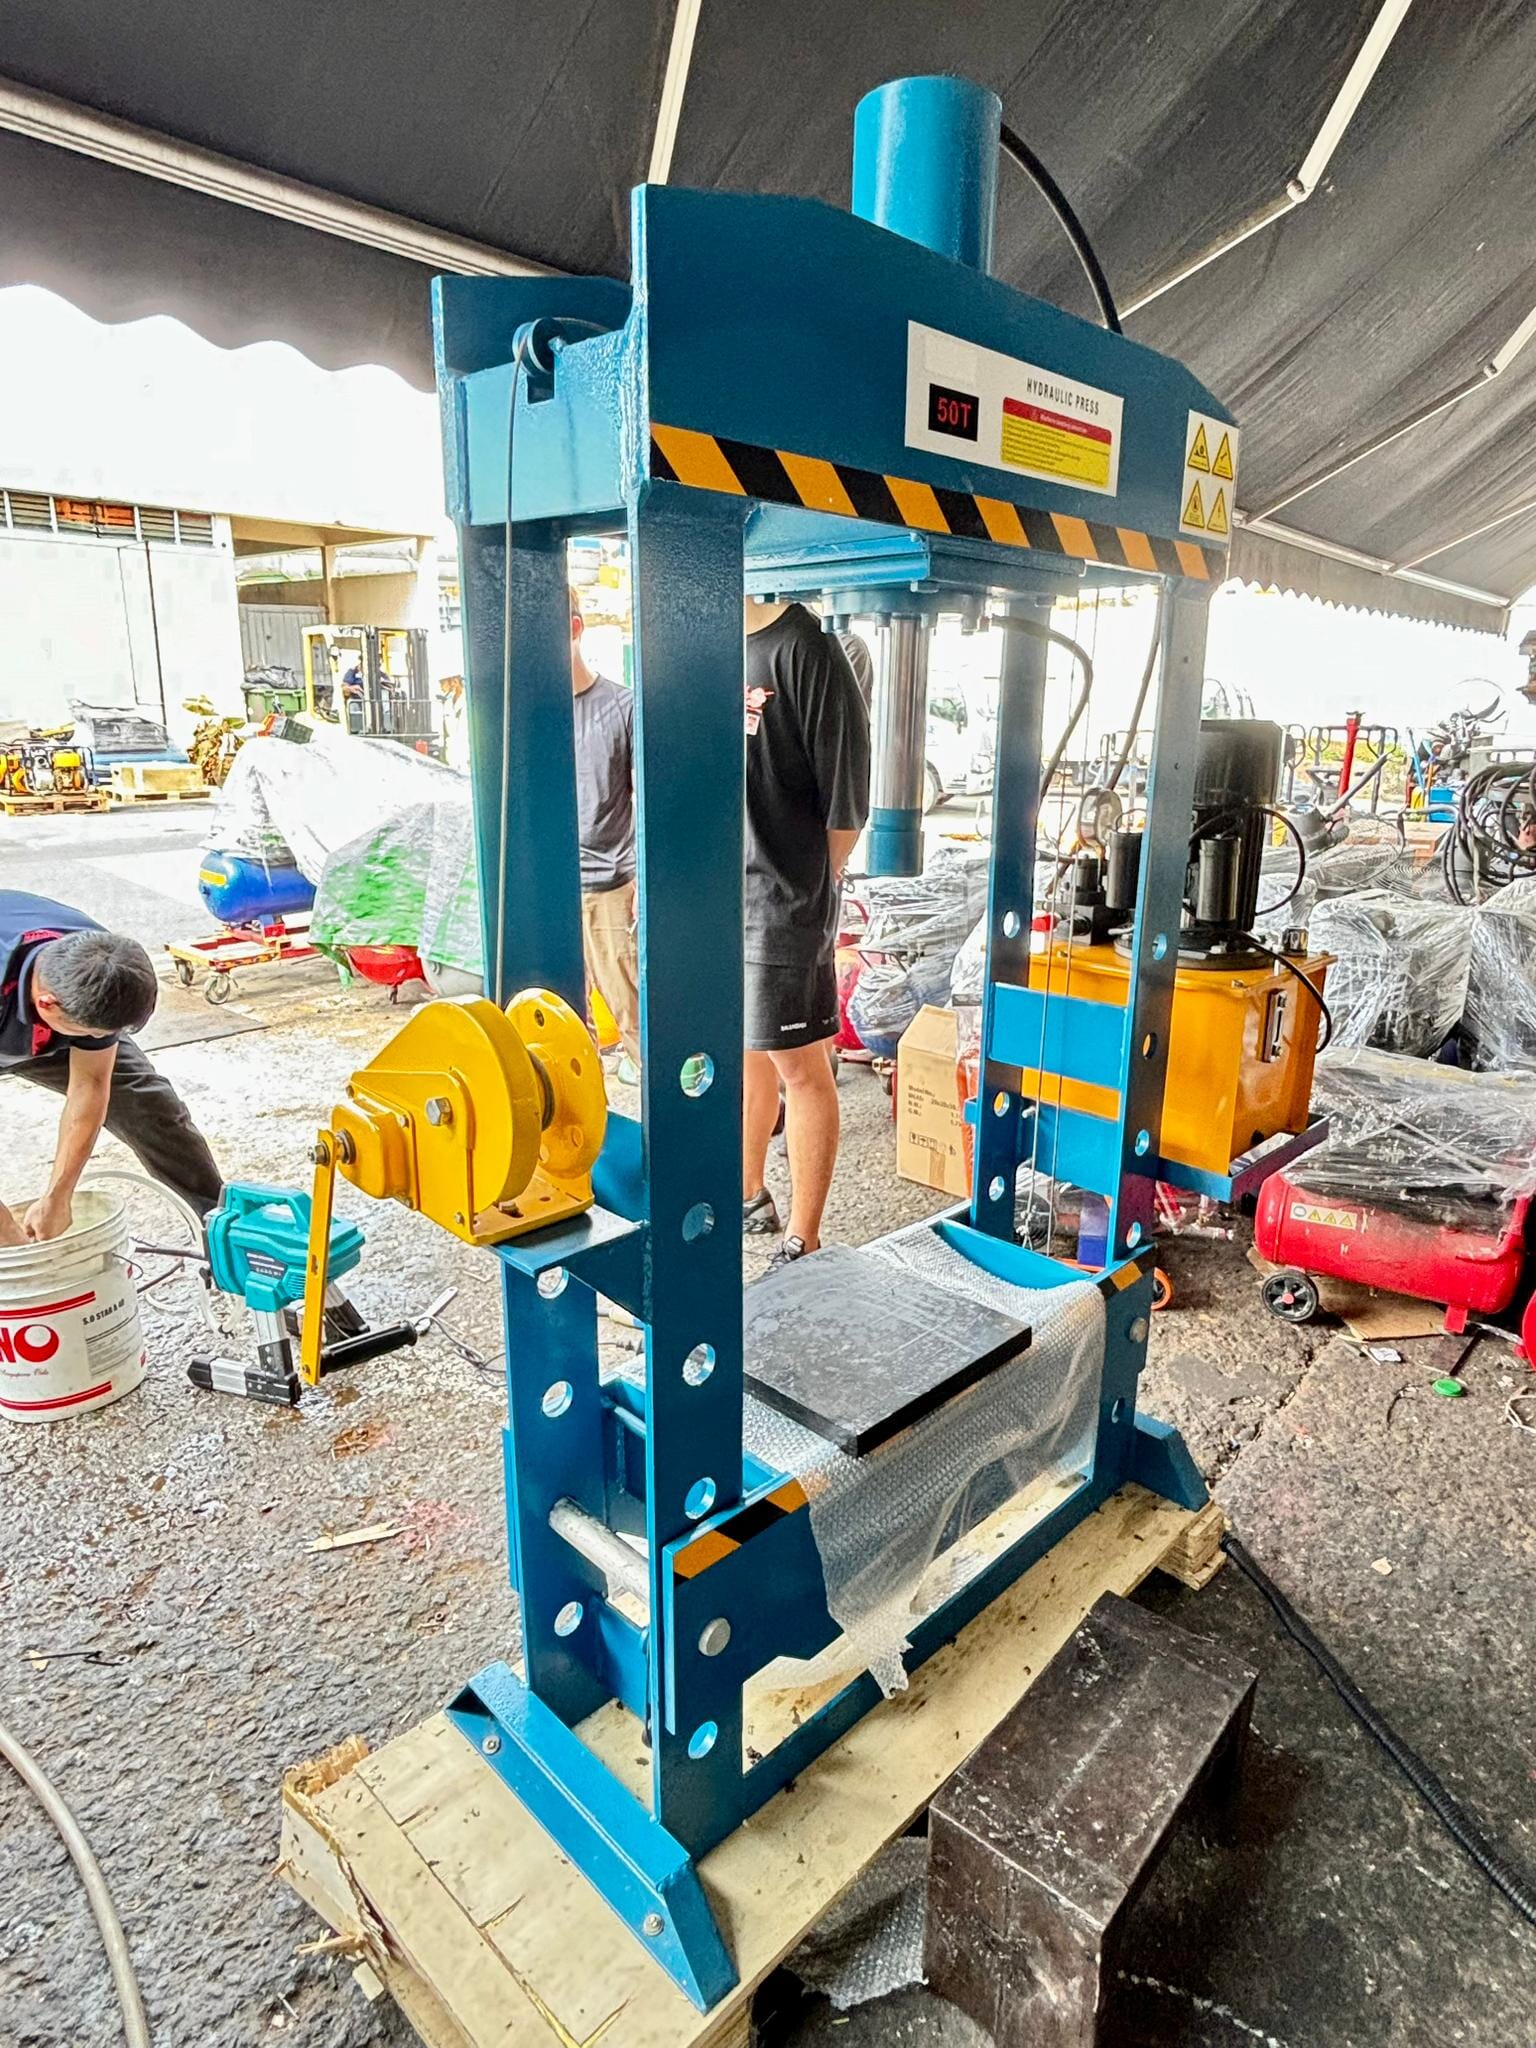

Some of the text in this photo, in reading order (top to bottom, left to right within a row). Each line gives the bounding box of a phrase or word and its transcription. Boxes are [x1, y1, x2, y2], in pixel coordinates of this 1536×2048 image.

[937, 396, 972, 429] 50T
[1026, 377, 1100, 416] HYDRAULIC PRESS
